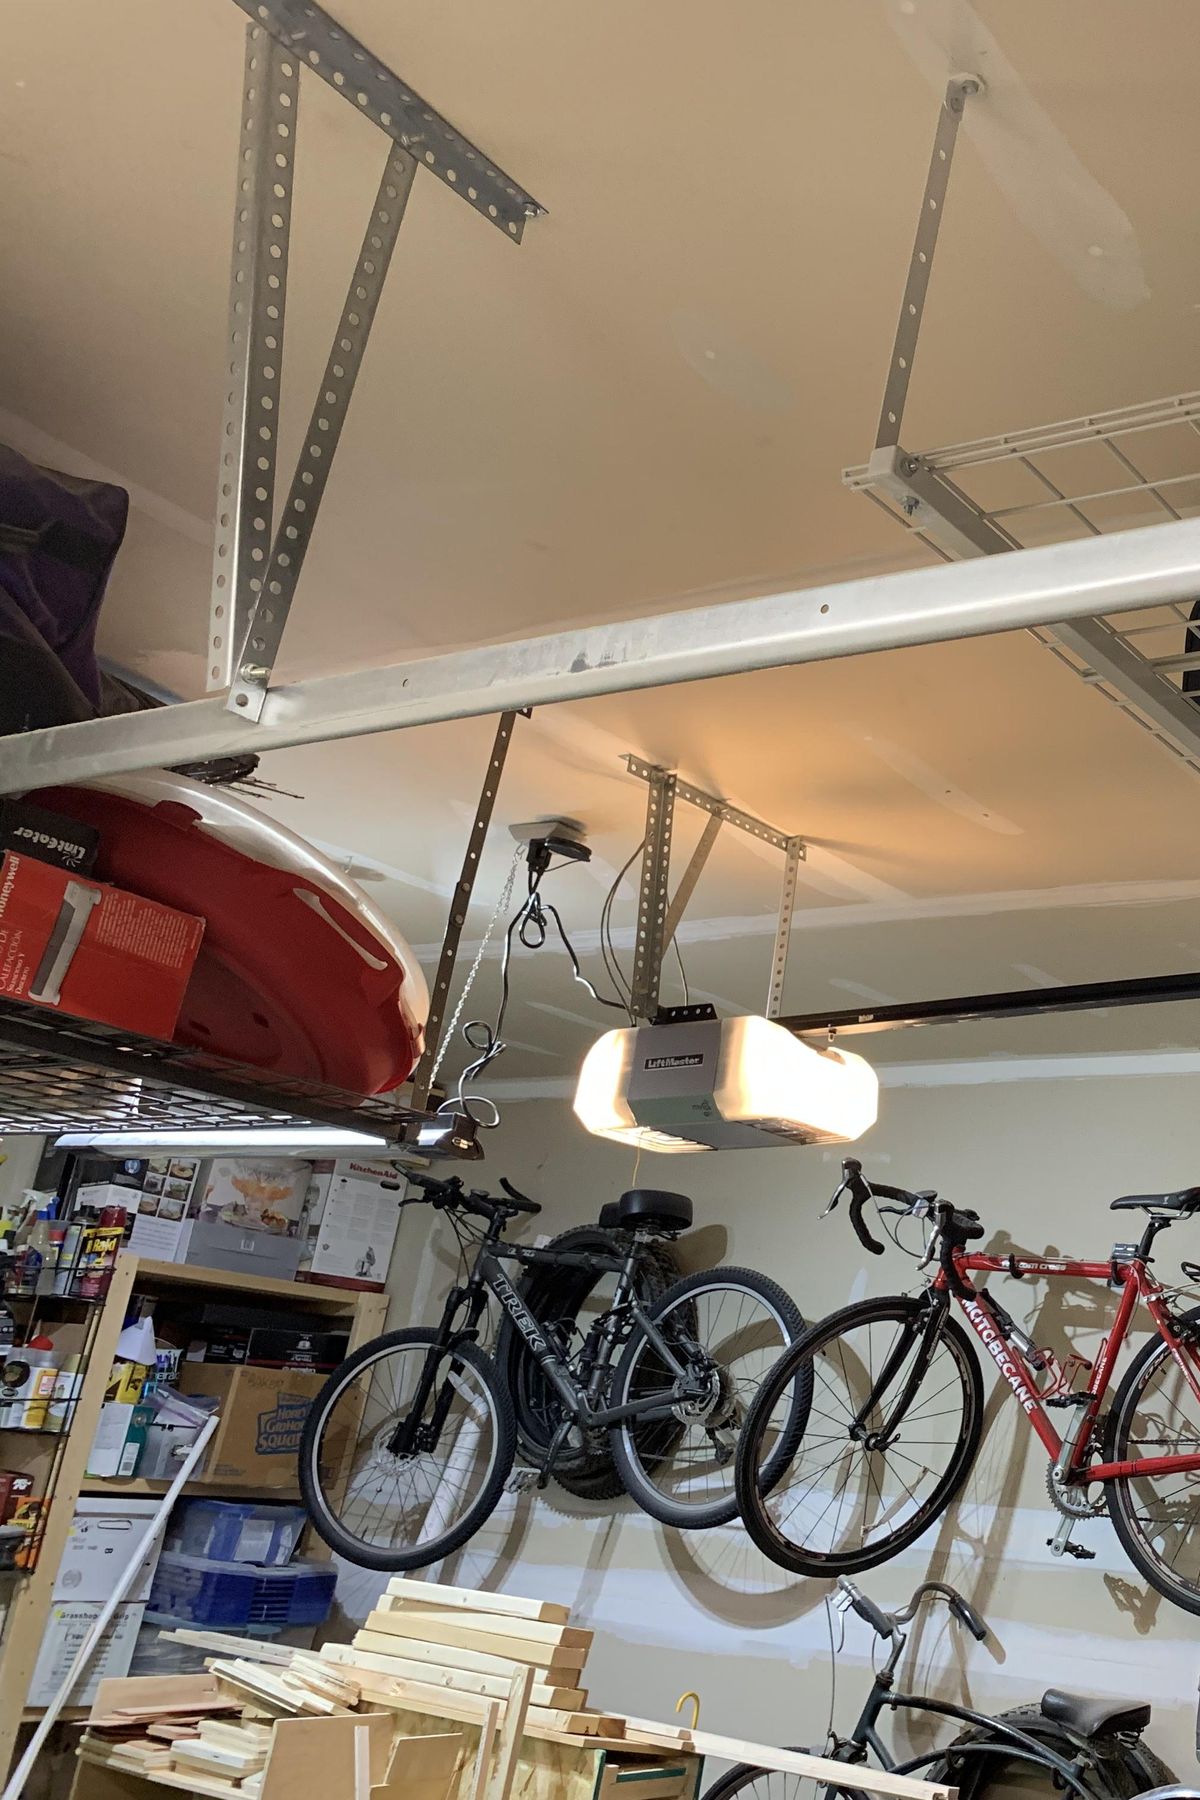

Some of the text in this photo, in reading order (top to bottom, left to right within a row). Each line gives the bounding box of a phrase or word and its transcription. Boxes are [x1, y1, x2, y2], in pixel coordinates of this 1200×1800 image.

[648, 1057, 700, 1068] LiftMaster
[349, 1163, 399, 1179] KitchenAid
[92, 1238, 118, 1252] Raid
[493, 1273, 546, 1351] TREK
[961, 1298, 1038, 1414] MOTOBECANE
[1091, 1356, 1107, 1395] OBECANE
[59, 1612, 98, 1620] Grasshop
